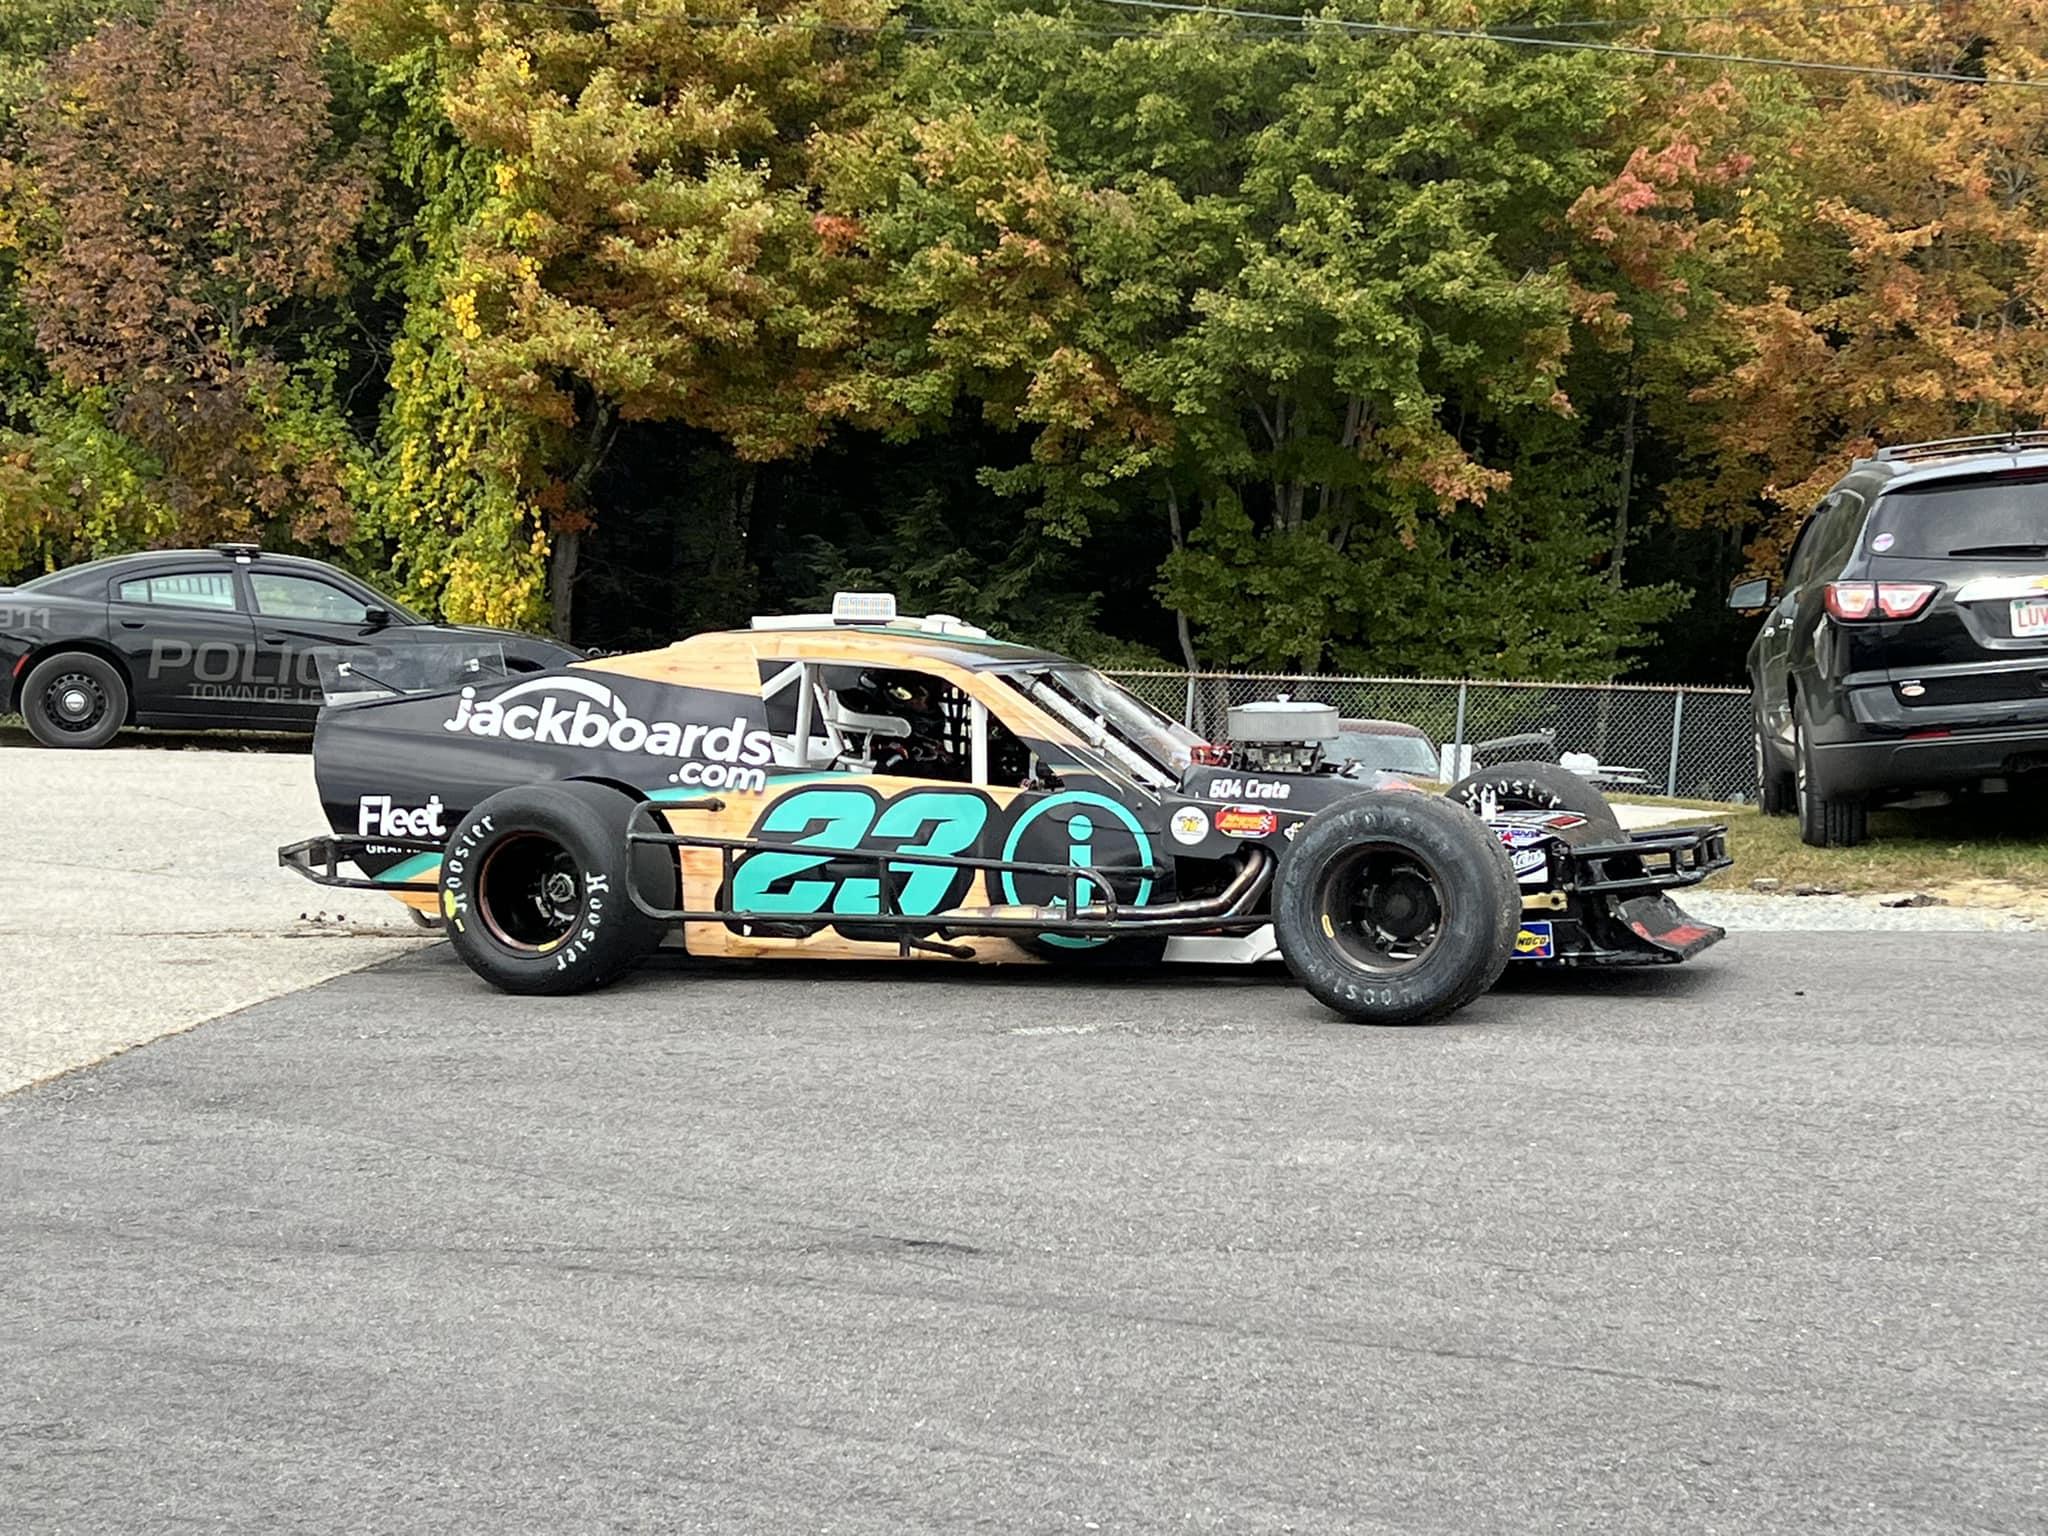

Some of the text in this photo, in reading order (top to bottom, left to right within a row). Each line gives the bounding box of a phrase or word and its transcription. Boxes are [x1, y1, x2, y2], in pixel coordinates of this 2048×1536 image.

[149, 638, 326, 686] POLIC
[189, 683, 258, 700] TOWN
[265, 686, 294, 702] OF
[443, 686, 772, 766] jackboards
[668, 761, 766, 792] .com
[1209, 779, 1291, 799] 604 Crate
[359, 795, 447, 837] Fleet
[732, 791, 987, 917] 23
